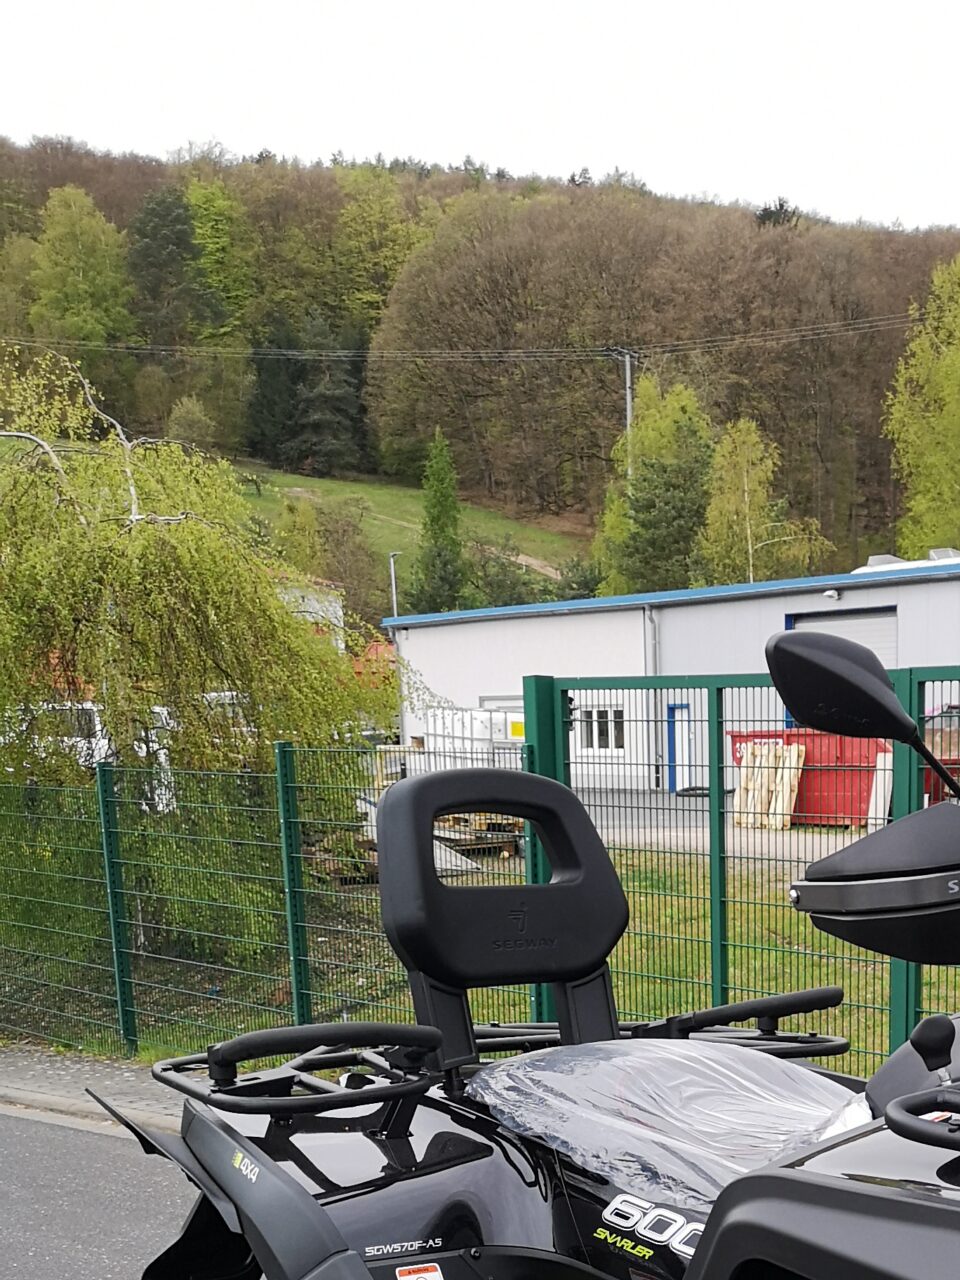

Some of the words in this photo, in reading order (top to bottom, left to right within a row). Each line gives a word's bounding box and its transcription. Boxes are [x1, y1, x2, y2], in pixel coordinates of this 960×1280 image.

[492, 937, 558, 951] SEGWAY
[365, 1238, 442, 1256] SGW570F-A5
[594, 1227, 654, 1259] SNARLER
